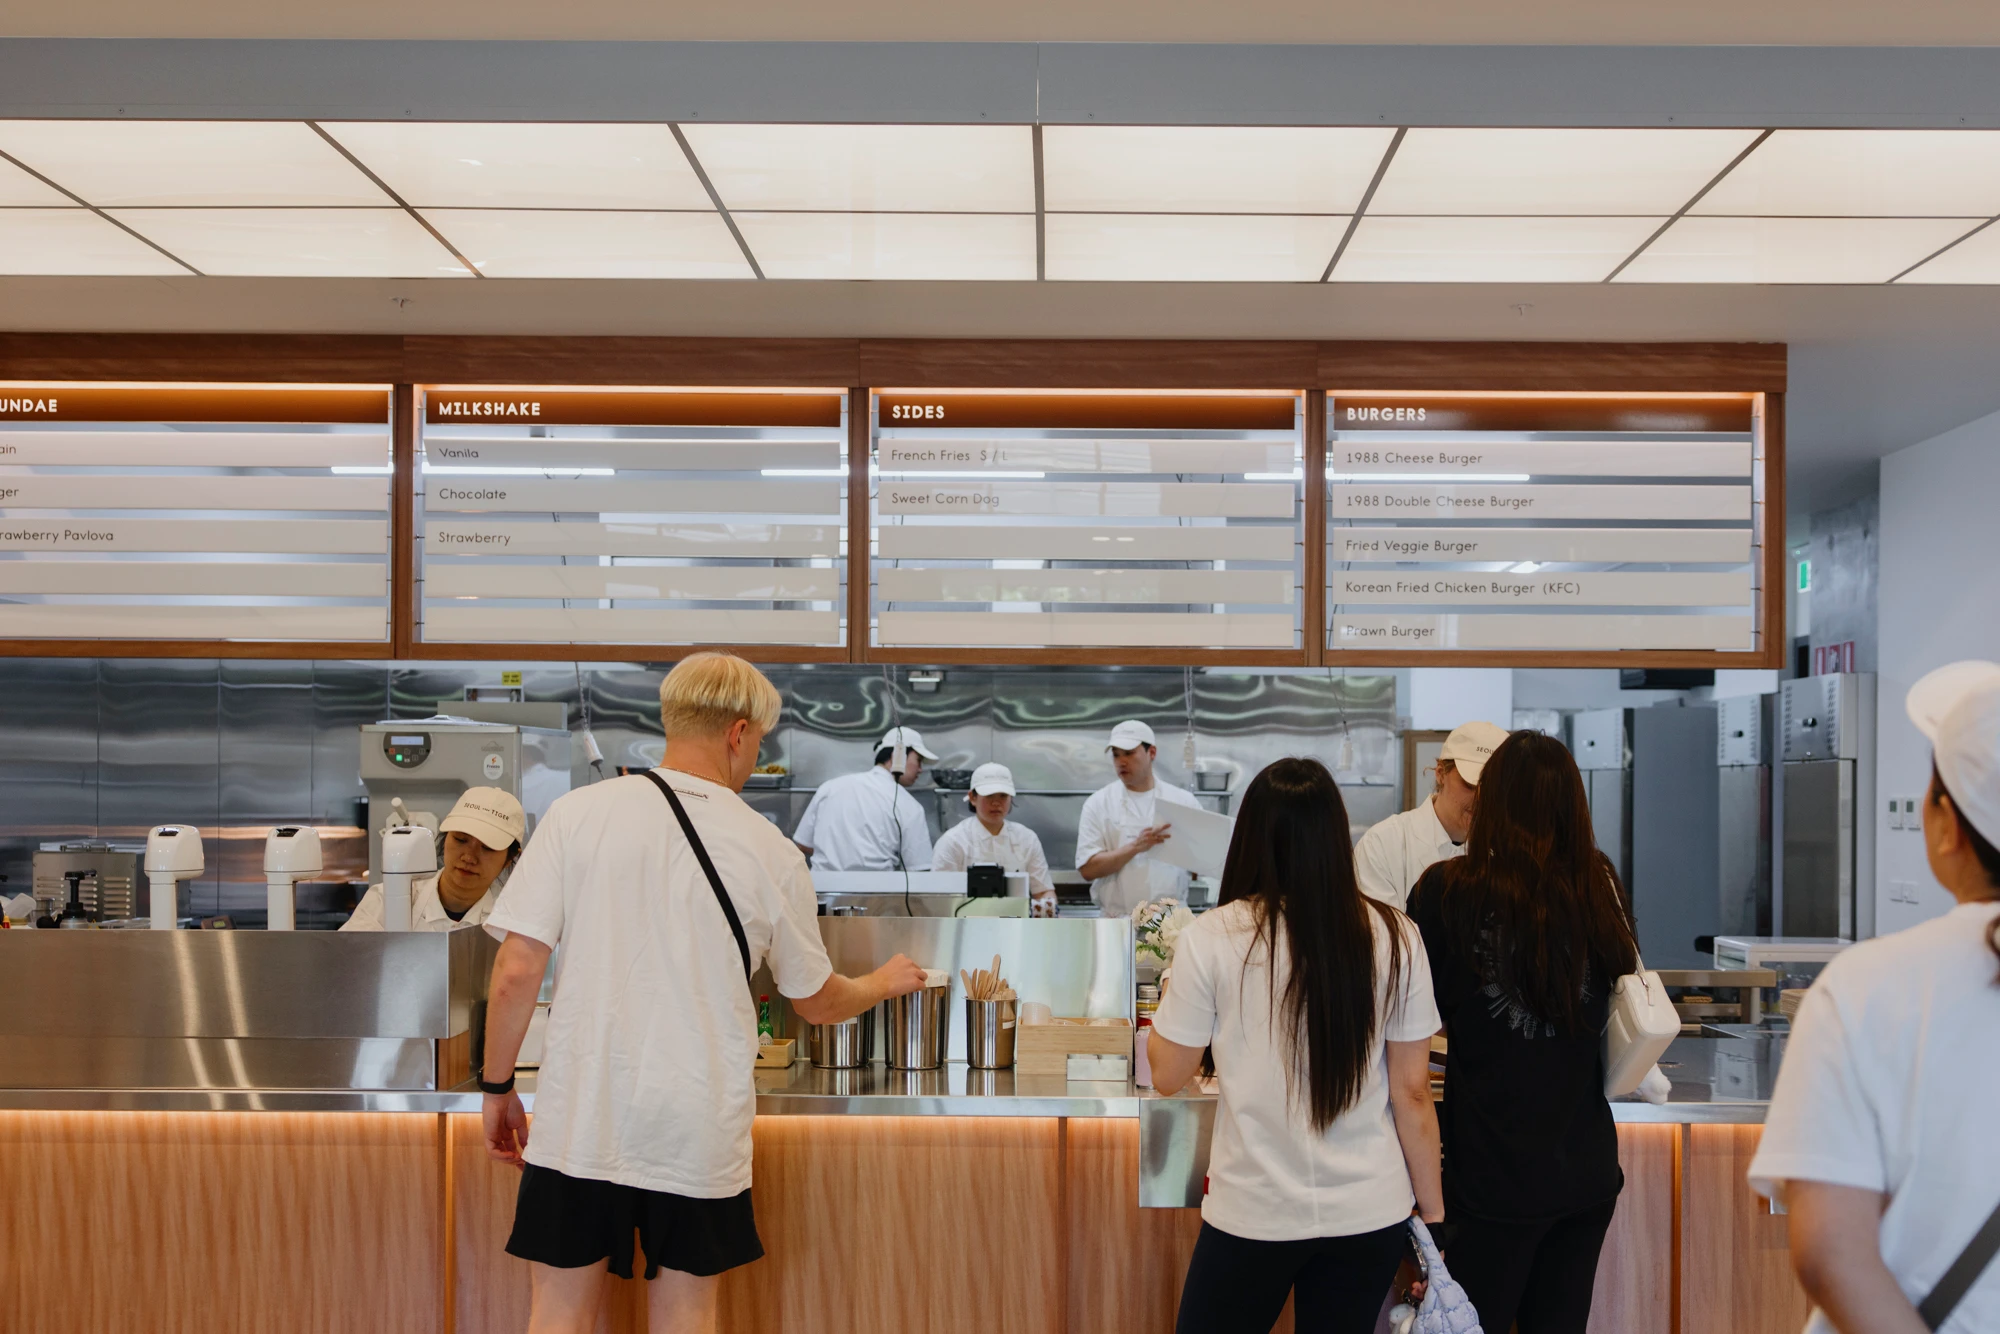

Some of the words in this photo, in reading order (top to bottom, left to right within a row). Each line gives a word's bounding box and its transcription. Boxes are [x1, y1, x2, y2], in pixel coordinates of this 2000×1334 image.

[439, 402, 541, 416] MILKSHAKE
[892, 405, 945, 419] SIDES
[1347, 407, 1426, 421] BURGERS
[439, 448, 479, 459] Vanila
[892, 450, 935, 461] French
[941, 449, 970, 461] Fries
[980, 449, 987, 461] S
[992, 449, 998, 462] /
[1002, 450, 1008, 461] L
[1347, 452, 1379, 463] 1988
[1385, 452, 1434, 464] Cheese
[1440, 453, 1483, 466] Burger
[439, 488, 506, 500] Chocolate
[892, 492, 929, 504] Sweet
[935, 492, 968, 504] Corn
[973, 493, 999, 507] Dog
[1347, 495, 1379, 506] 1988
[1385, 495, 1430, 507] Double
[1436, 496, 1485, 507] Cheese
[1490, 496, 1534, 510] Burger
[64, 529, 114, 541] Pavlova
[439, 531, 511, 546] Strawberry
[1346, 539, 1379, 551] Fried
[1384, 540, 1429, 554] Veggie
[1435, 540, 1478, 554] Burger
[1346, 582, 1392, 593] Korean
[1397, 581, 1429, 593] Fried
[1434, 581, 1486, 593] Chicken
[1491, 582, 1535, 596] Burger
[1542, 582, 1580, 595] (KFC)
[1347, 625, 1386, 636] Prawn
[1392, 626, 1435, 639] Burger
[1476, 746, 1495, 754] SEOU
[491, 809, 510, 821] TIGER
